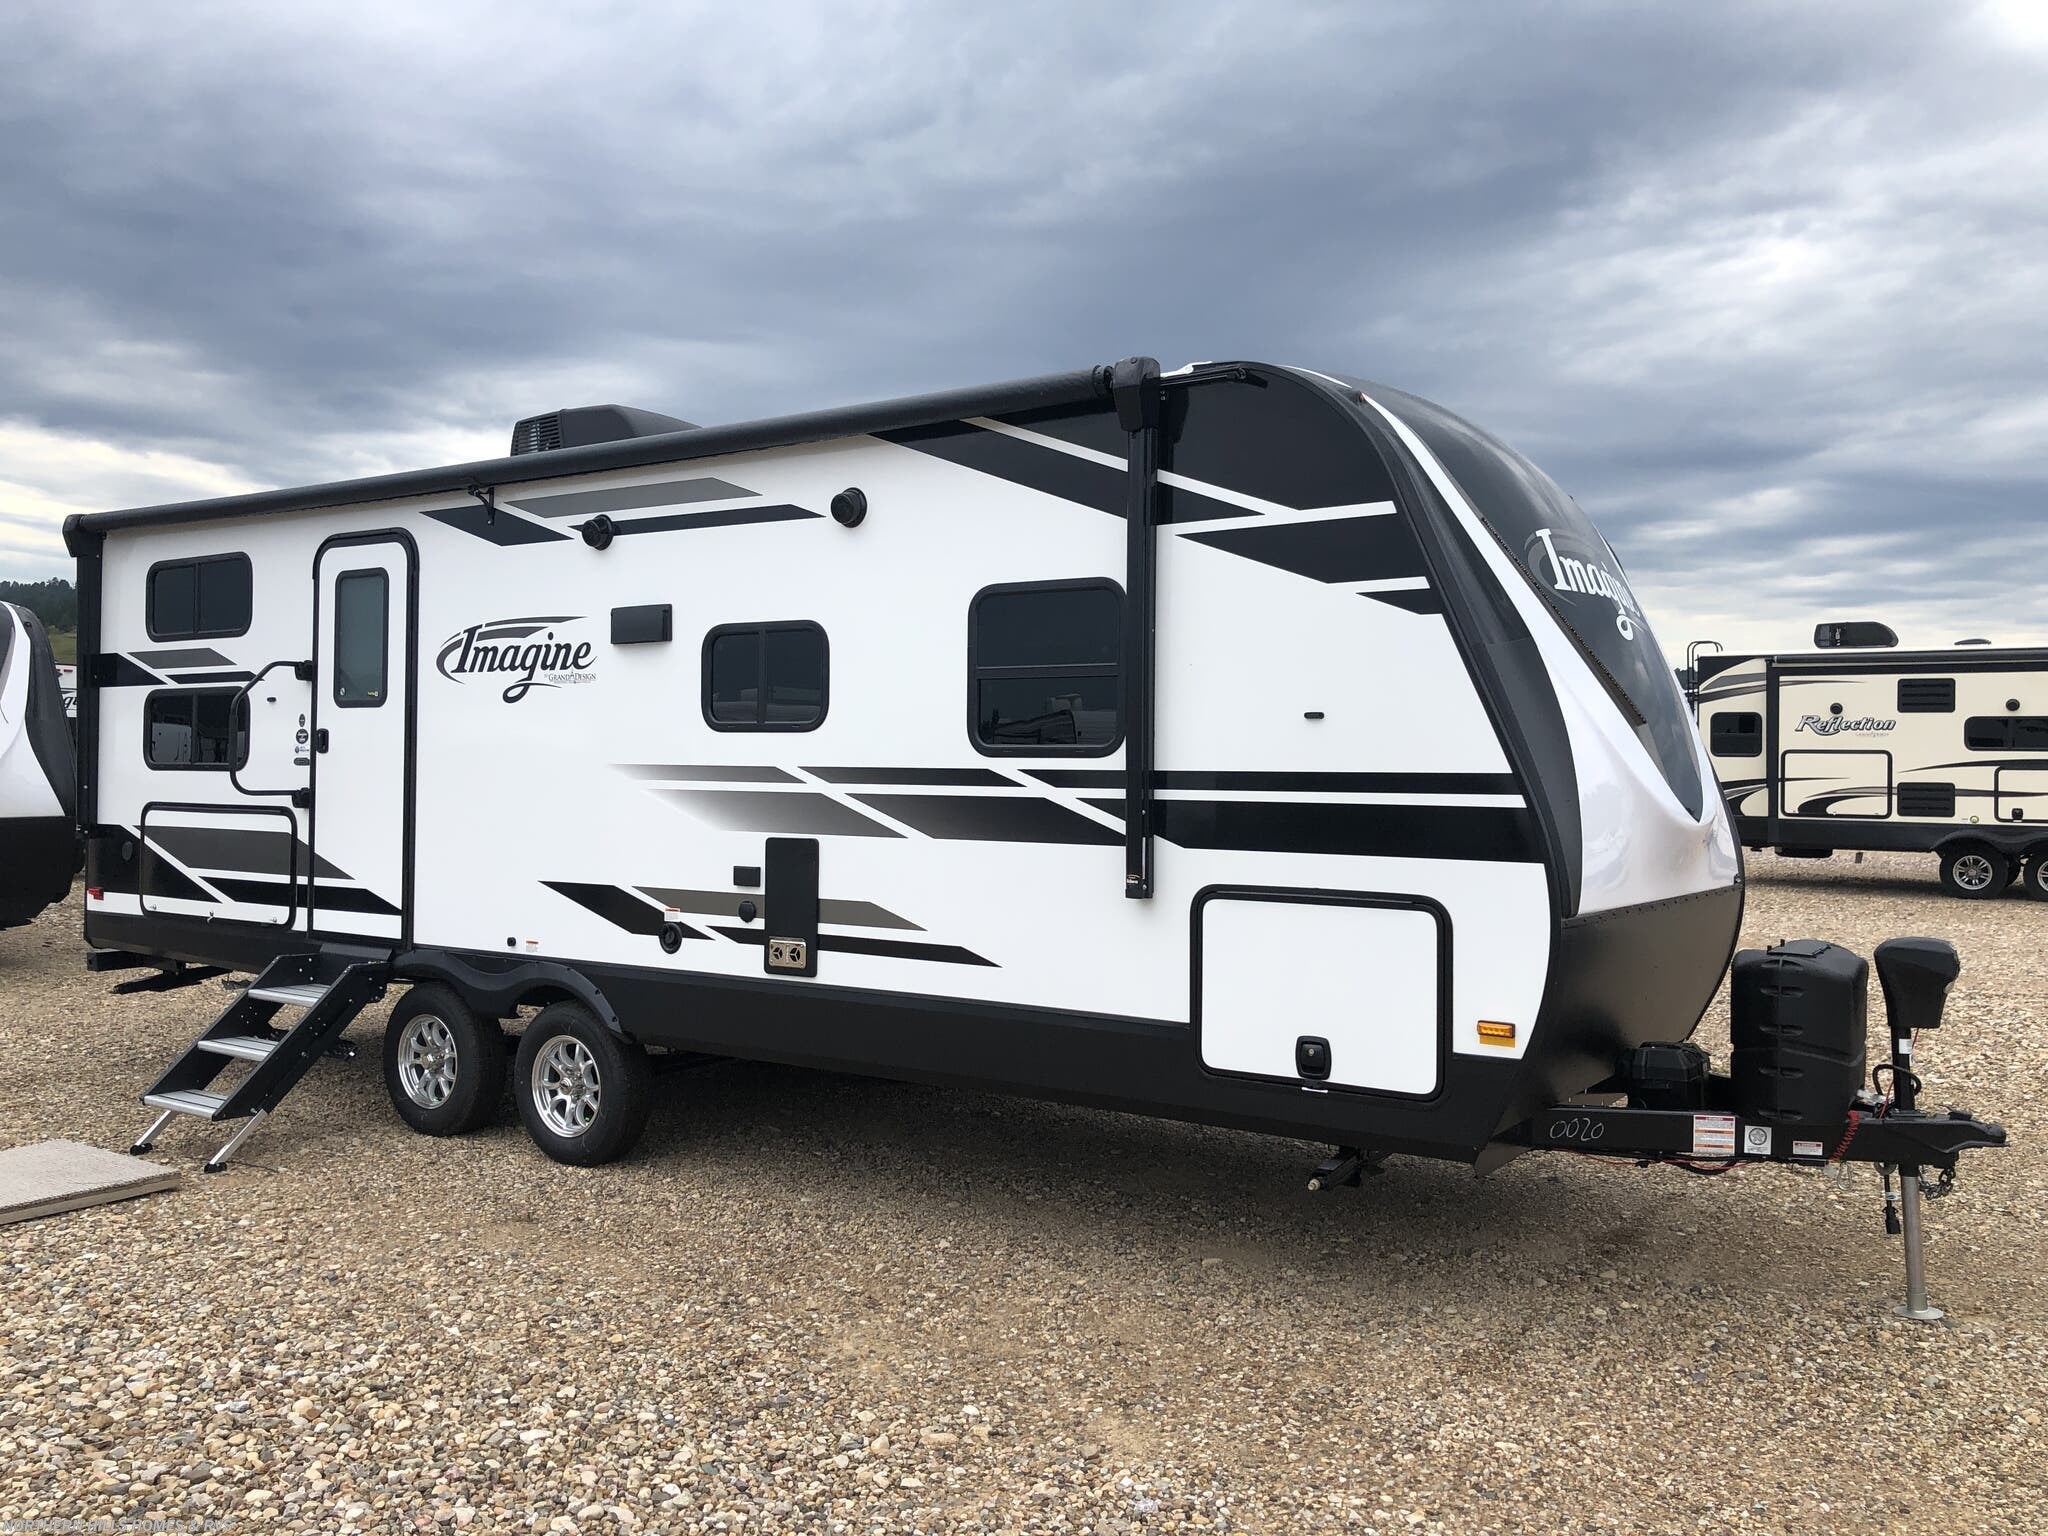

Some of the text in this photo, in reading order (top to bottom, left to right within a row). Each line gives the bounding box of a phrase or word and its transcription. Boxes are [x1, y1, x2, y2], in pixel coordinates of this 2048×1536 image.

[451, 623, 598, 704] Imagine
[1795, 714, 1897, 736] Reflection
[1550, 1117, 1605, 1142] 0020
